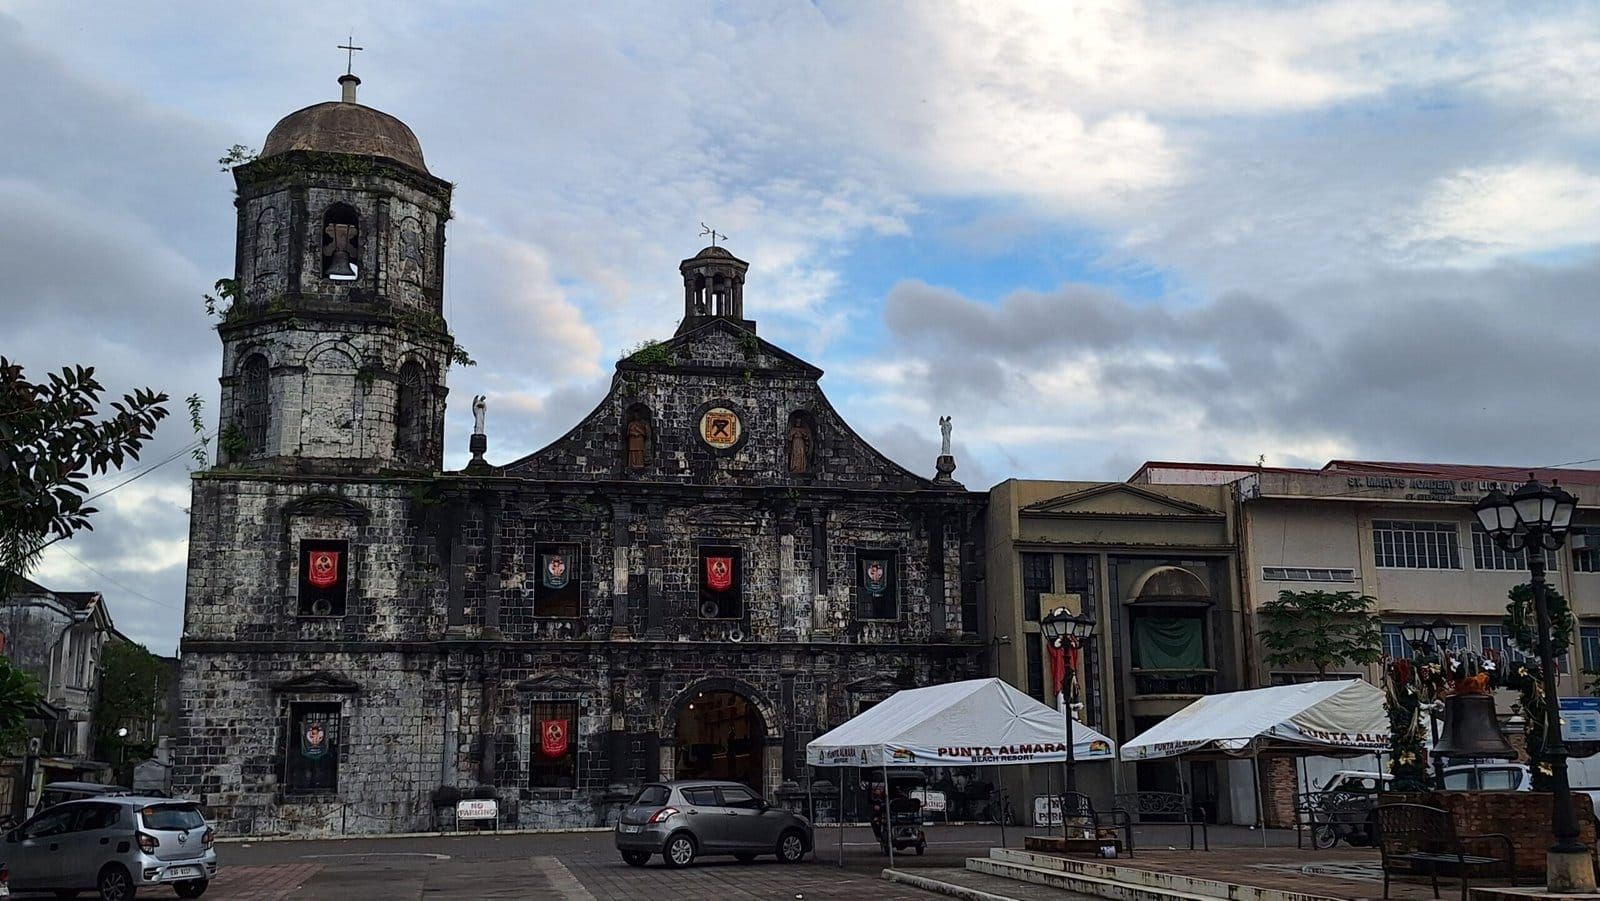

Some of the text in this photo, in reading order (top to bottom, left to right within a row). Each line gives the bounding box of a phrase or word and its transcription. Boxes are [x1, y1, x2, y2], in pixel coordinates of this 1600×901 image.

[1409, 479, 1456, 491] ACADEMY
[1460, 480, 1474, 491] OF
[938, 743, 1066, 757] PUNTA ALMARA
[971, 754, 1034, 763] BEACH RESORT
[460, 809, 496, 817] PARKING
